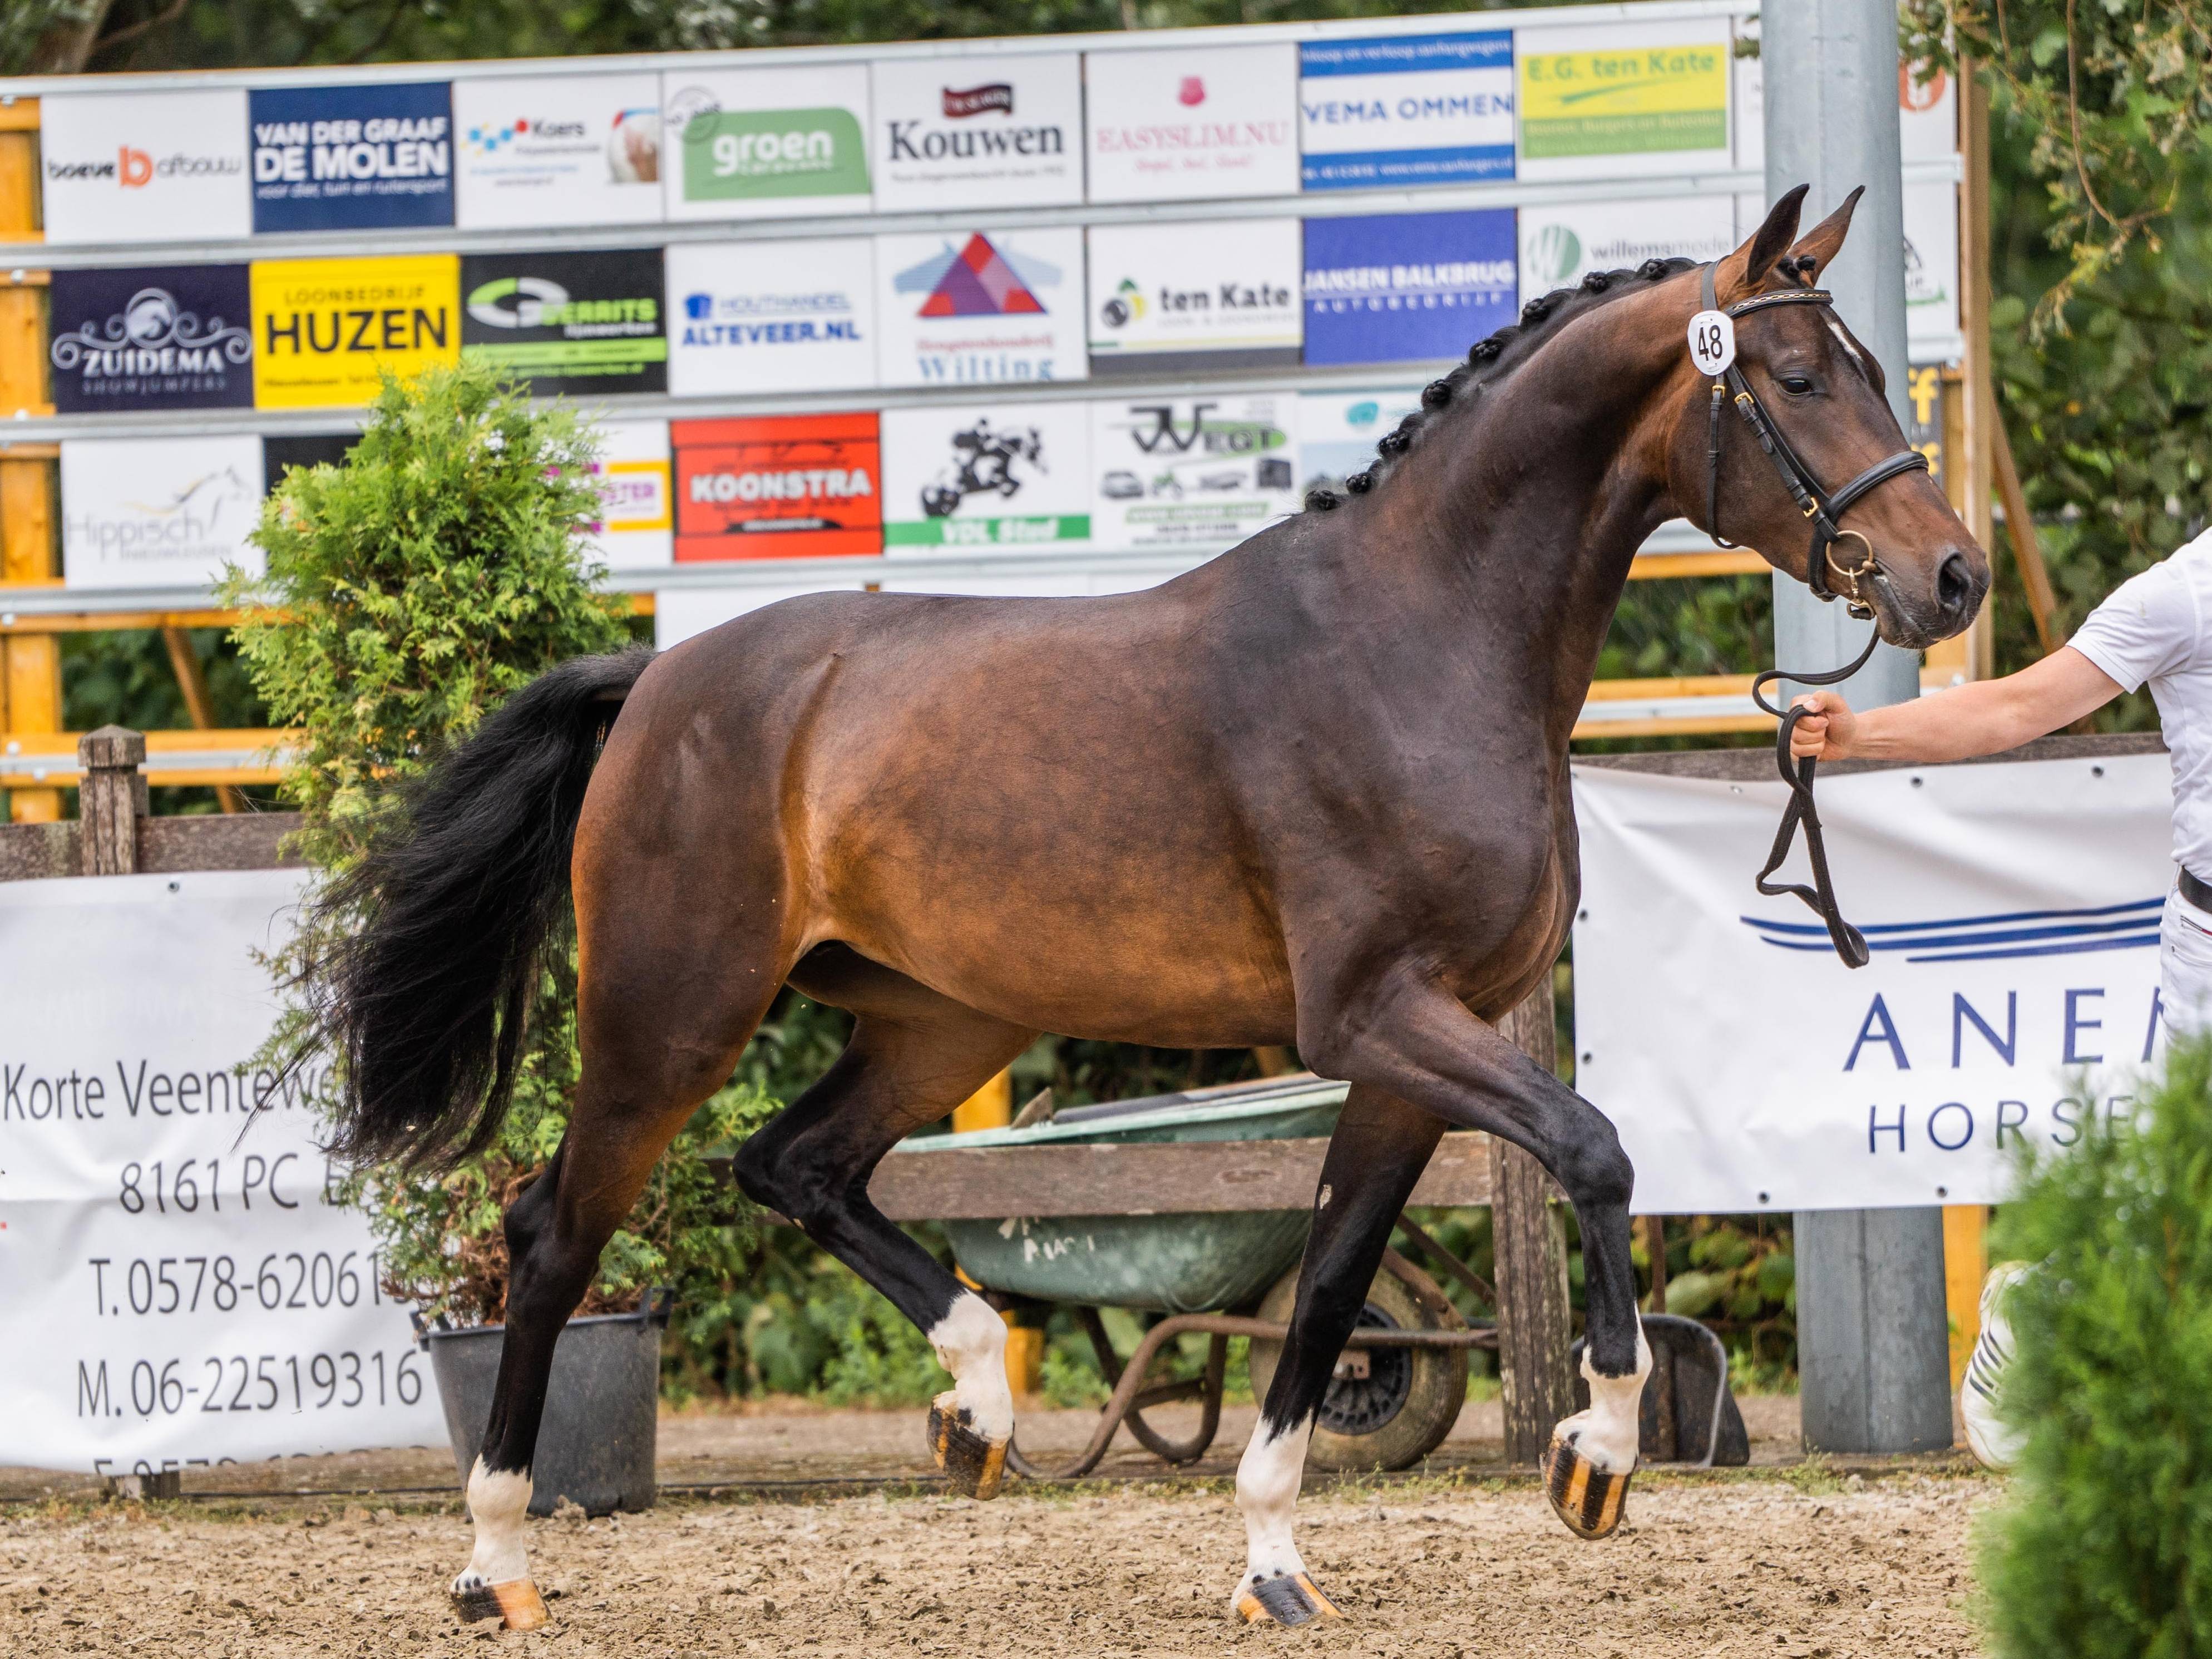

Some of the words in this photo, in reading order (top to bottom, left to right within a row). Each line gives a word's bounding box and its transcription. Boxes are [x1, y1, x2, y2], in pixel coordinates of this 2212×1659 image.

[1528, 56, 1582, 82] E.G.
[1592, 57, 1640, 78] ten
[1648, 51, 1716, 74] Kate
[1302, 100, 1389, 125] VEMA
[1398, 92, 1513, 119] OMMEN
[254, 121, 309, 146] VAN
[311, 119, 362, 145] DER
[363, 116, 447, 143] GRAAF
[887, 119, 1064, 161] Kouwen
[156, 152, 241, 178] afbouw
[254, 146, 307, 183] DE
[312, 140, 449, 180] MOLEN
[713, 131, 833, 177] groen
[1304, 266, 1390, 292] JANSEN
[1391, 259, 1515, 289] BALKBRUG
[284, 283, 424, 305] LOONBEDRIJF
[1159, 285, 1210, 312] ten
[1219, 281, 1290, 309] Kate
[266, 307, 447, 354] HUZEN
[682, 319, 862, 345] ALTEVEER.NL
[1698, 325, 1722, 361] 48
[82, 347, 224, 377] ZUIDEMA
[918, 354, 1054, 382] Wilting
[690, 468, 872, 503] KOONSTRA
[67, 507, 204, 562] Hippisch
[3, 1063, 105, 1120] Korte
[117, 1059, 337, 1118] Veentewe
[120, 1159, 220, 1214] 8161
[242, 1153, 299, 1211] PC
[88, 1251, 409, 1316] T.0578-62061
[78, 1349, 423, 1417] M.06-22519316
